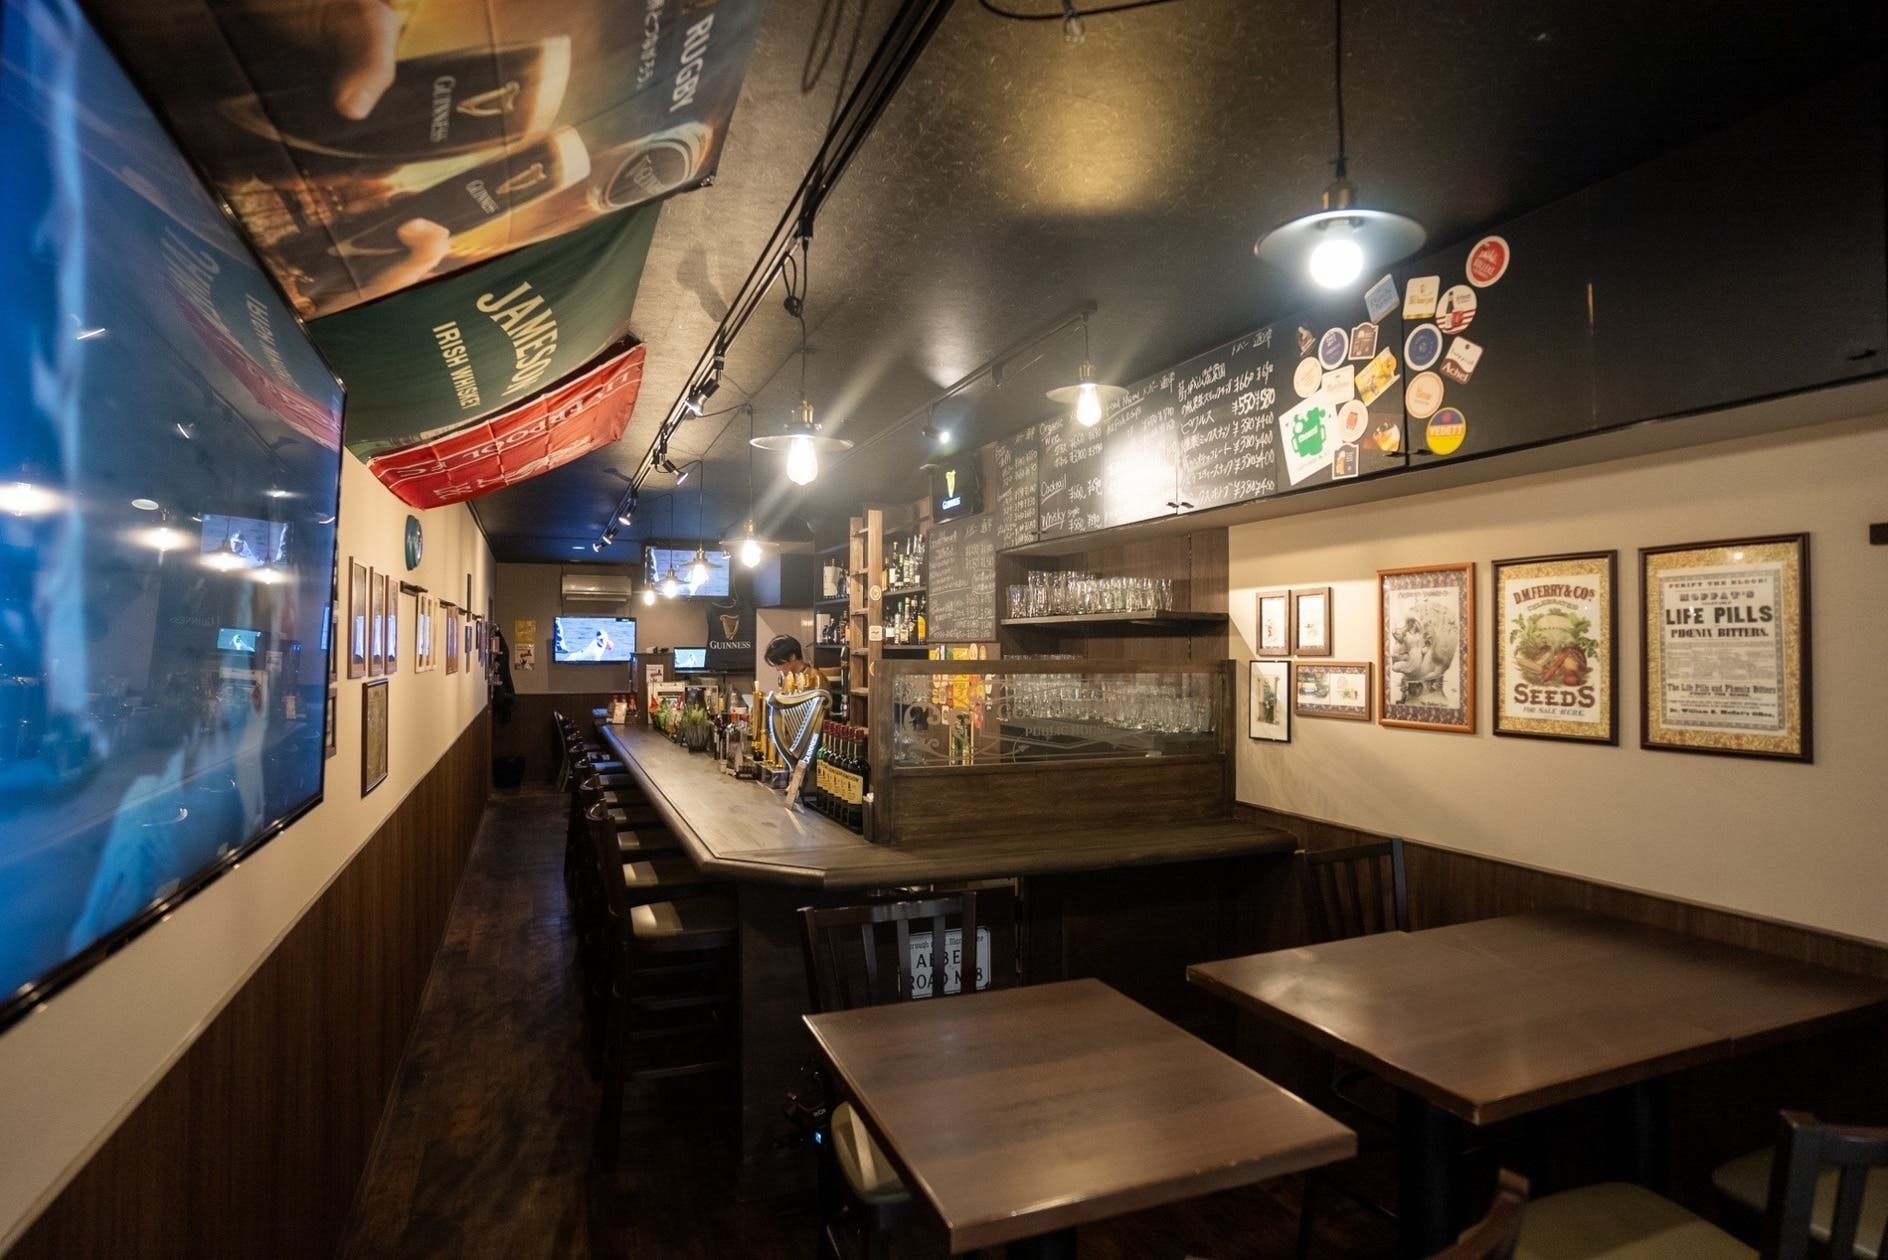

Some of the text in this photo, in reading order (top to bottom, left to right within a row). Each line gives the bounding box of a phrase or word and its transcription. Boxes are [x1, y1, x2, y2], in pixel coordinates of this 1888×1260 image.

[669, 13, 714, 112] RUGBY
[429, 75, 457, 144] GUINNESS
[432, 321, 481, 410] IRISH WHISKEY
[476, 281, 559, 397] JAMESON
[709, 640, 752, 650] GUINNESS
[1665, 605, 1773, 625] LIFE PILLS
[1514, 682, 1596, 709] SEEDS
